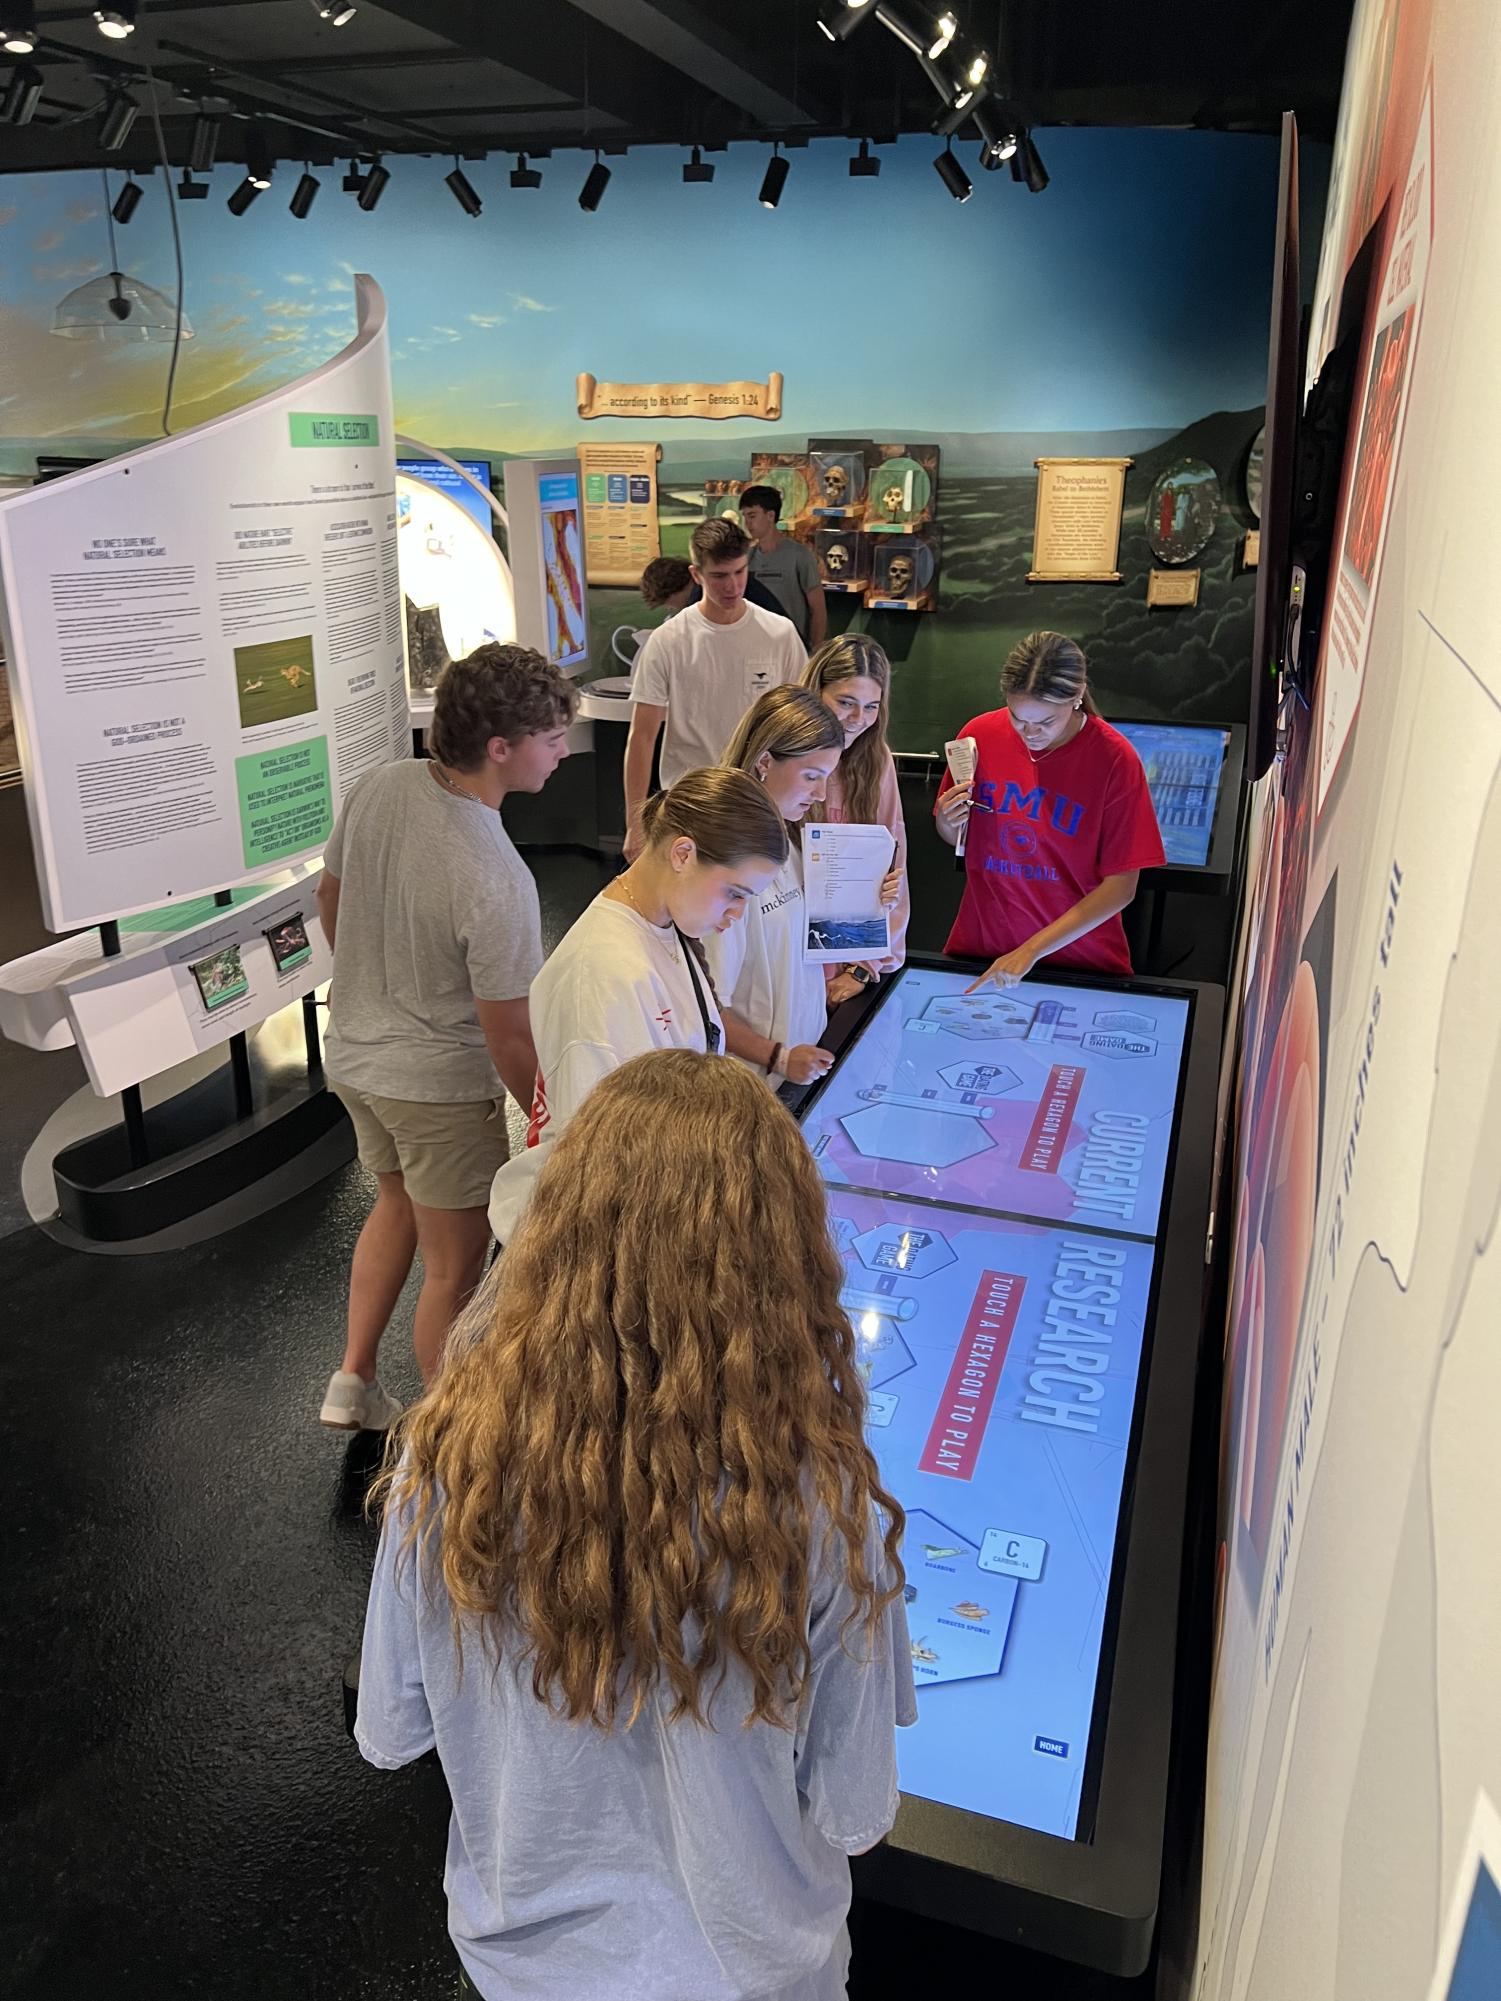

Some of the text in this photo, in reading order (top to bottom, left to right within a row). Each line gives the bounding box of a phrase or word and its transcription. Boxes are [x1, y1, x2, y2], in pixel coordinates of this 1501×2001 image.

[610, 397, 648, 409] according
[650, 397, 657, 407] to
[659, 396, 669, 406] its
[708, 393, 739, 405] Genesis
[742, 394, 759, 406] 1:24
[312, 421, 370, 440] NATURAL SELECTION
[1056, 475, 1107, 486] Theophanies
[977, 781, 1088, 838] SMU
[1055, 1068, 1076, 1089] TOUCH
[1042, 1099, 1067, 1134] HEXAGON
[1037, 1135, 1056, 1146] TO
[1030, 1148, 1052, 1170] PLAY
[1072, 1110, 1148, 1221] CURRENT
[876, 1244, 898, 1266] GAME
[1264, 1480, 1295, 1688] HUMAN
[1295, 1320, 1321, 1496] MALE
[1329, 1193, 1344, 1281] 72
[1344, 985, 1381, 1196] inches
[1380, 858, 1403, 969] tall
[1020, 1241, 1128, 1434] RESEARCH
[934, 1277, 1014, 1472] TOUCH A HEXAGON TO PLAY
[1006, 1540, 1020, 1558] C
[993, 1555, 1030, 1569] CARBON-14
[1039, 1740, 1064, 1755] HOME
